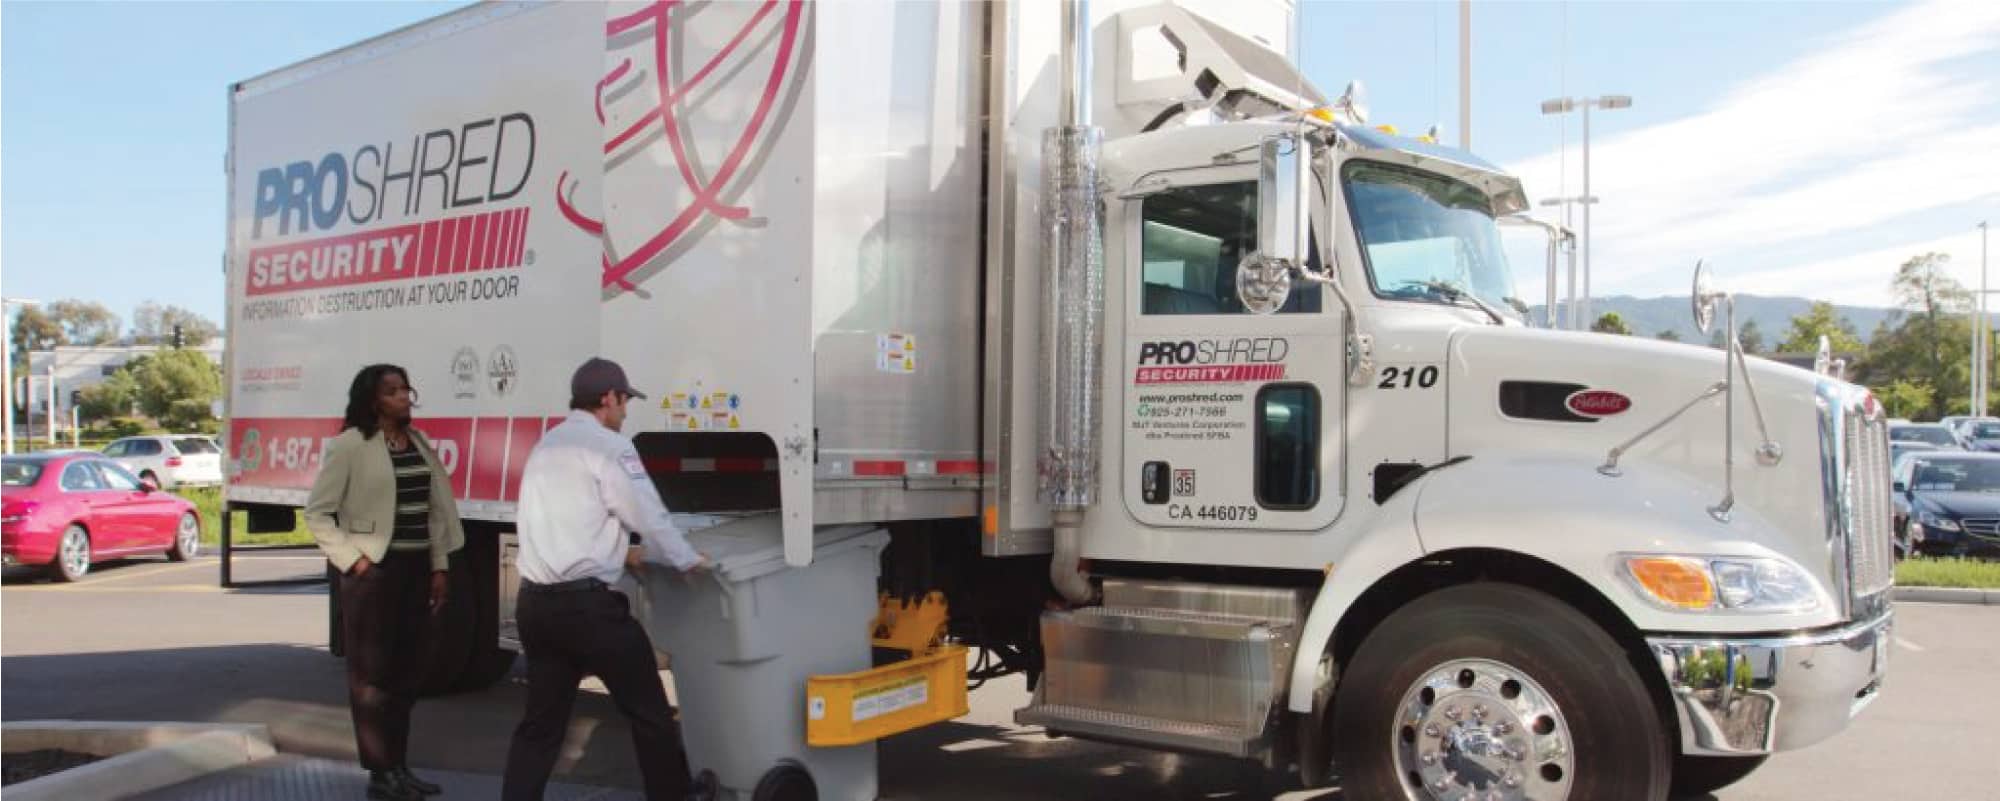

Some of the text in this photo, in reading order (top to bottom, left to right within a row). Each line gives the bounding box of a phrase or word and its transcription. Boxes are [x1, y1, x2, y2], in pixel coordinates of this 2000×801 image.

[252, 112, 535, 239] PROSHRED
[251, 234, 414, 287] SECURITY
[242, 275, 520, 322] INFORMATION DESTRUCTION AT YOUR DOOR
[1138, 337, 1290, 365] PROSHRED
[1138, 367, 1232, 381] SECURITY
[1377, 365, 1440, 390] 210
[1176, 476, 1192, 494] 35
[1168, 504, 1259, 521] CA 446079
